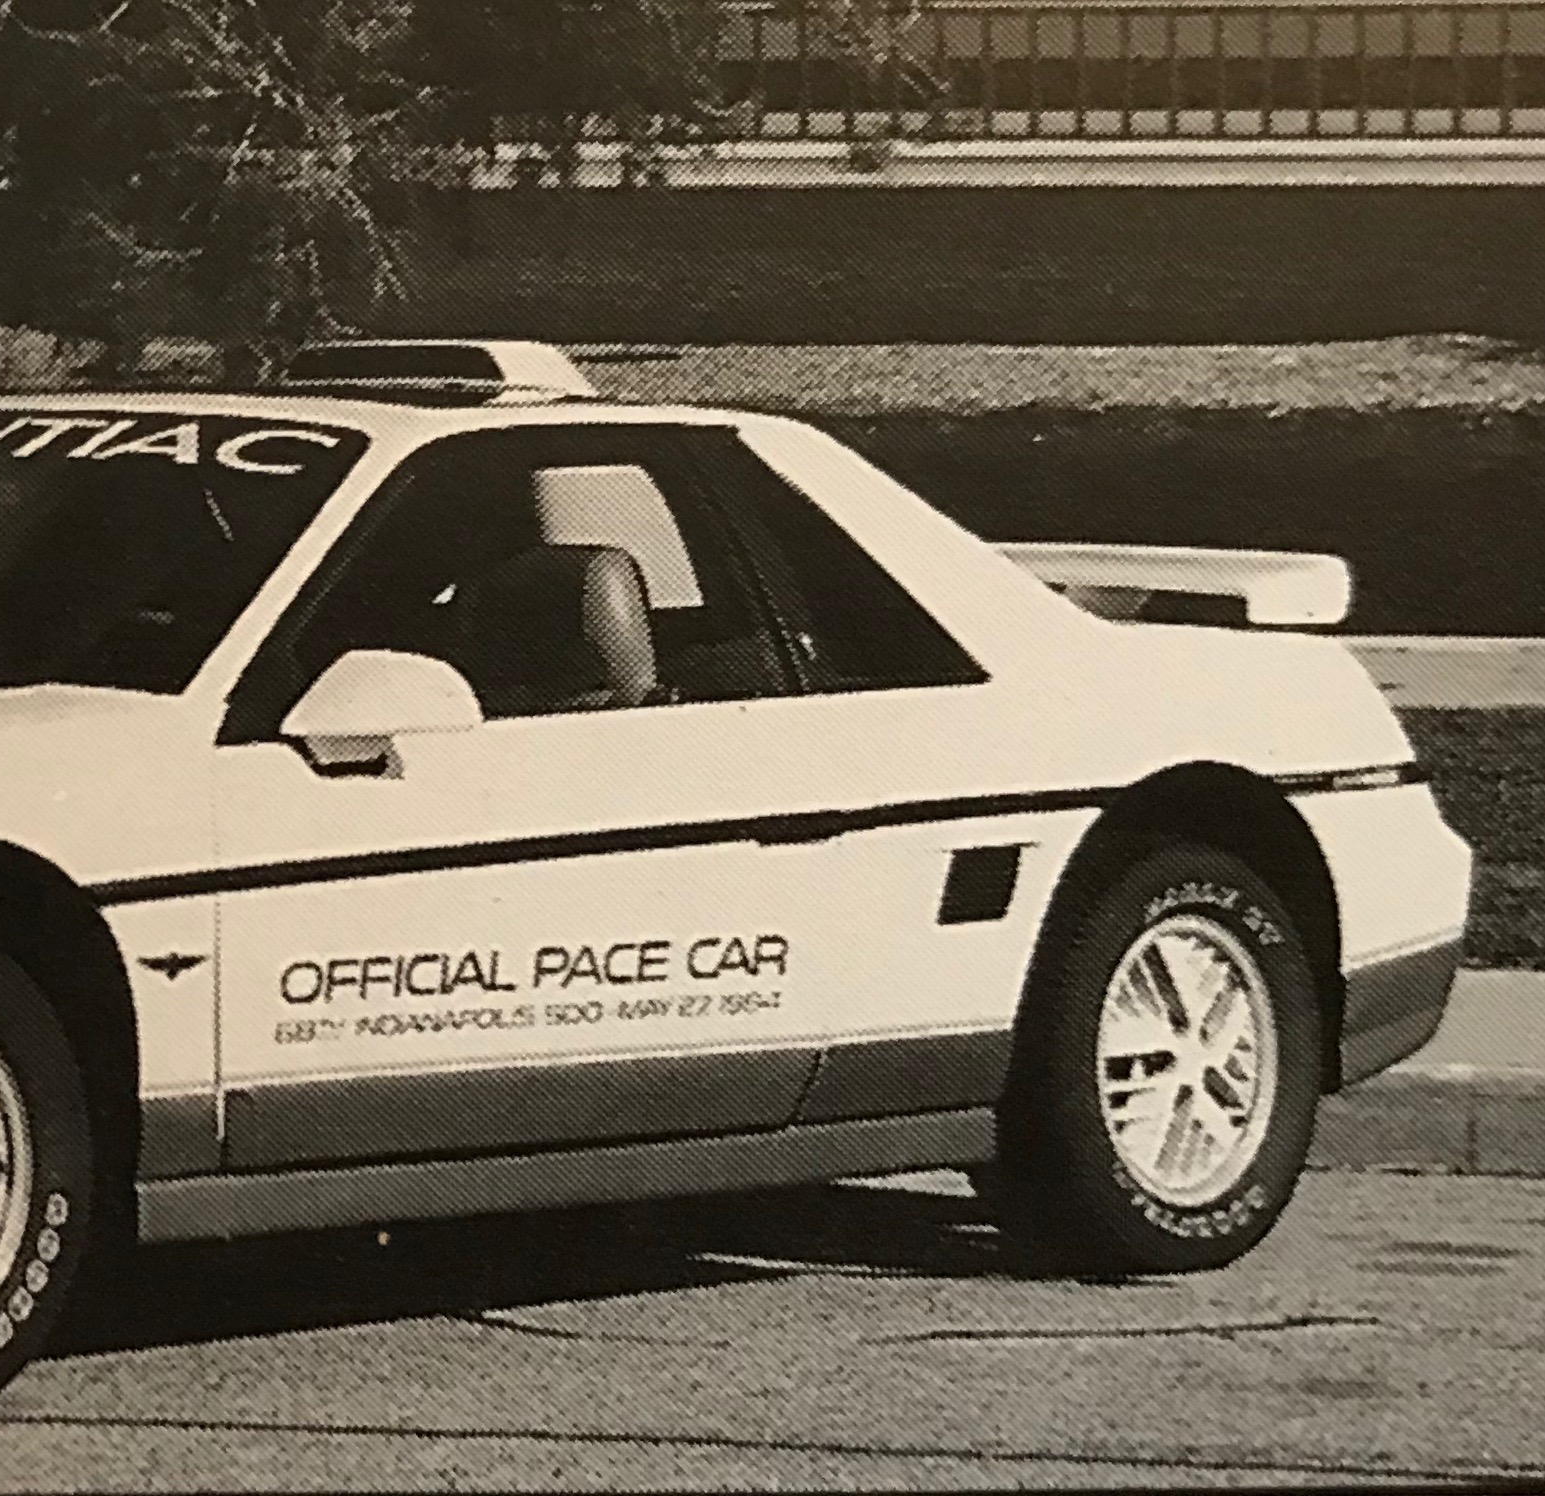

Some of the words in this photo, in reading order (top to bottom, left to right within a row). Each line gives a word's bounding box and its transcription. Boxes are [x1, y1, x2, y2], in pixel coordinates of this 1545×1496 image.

[280, 949, 518, 1004] OFFICIAL
[533, 940, 671, 989] PACE
[686, 934, 789, 980] CAR
